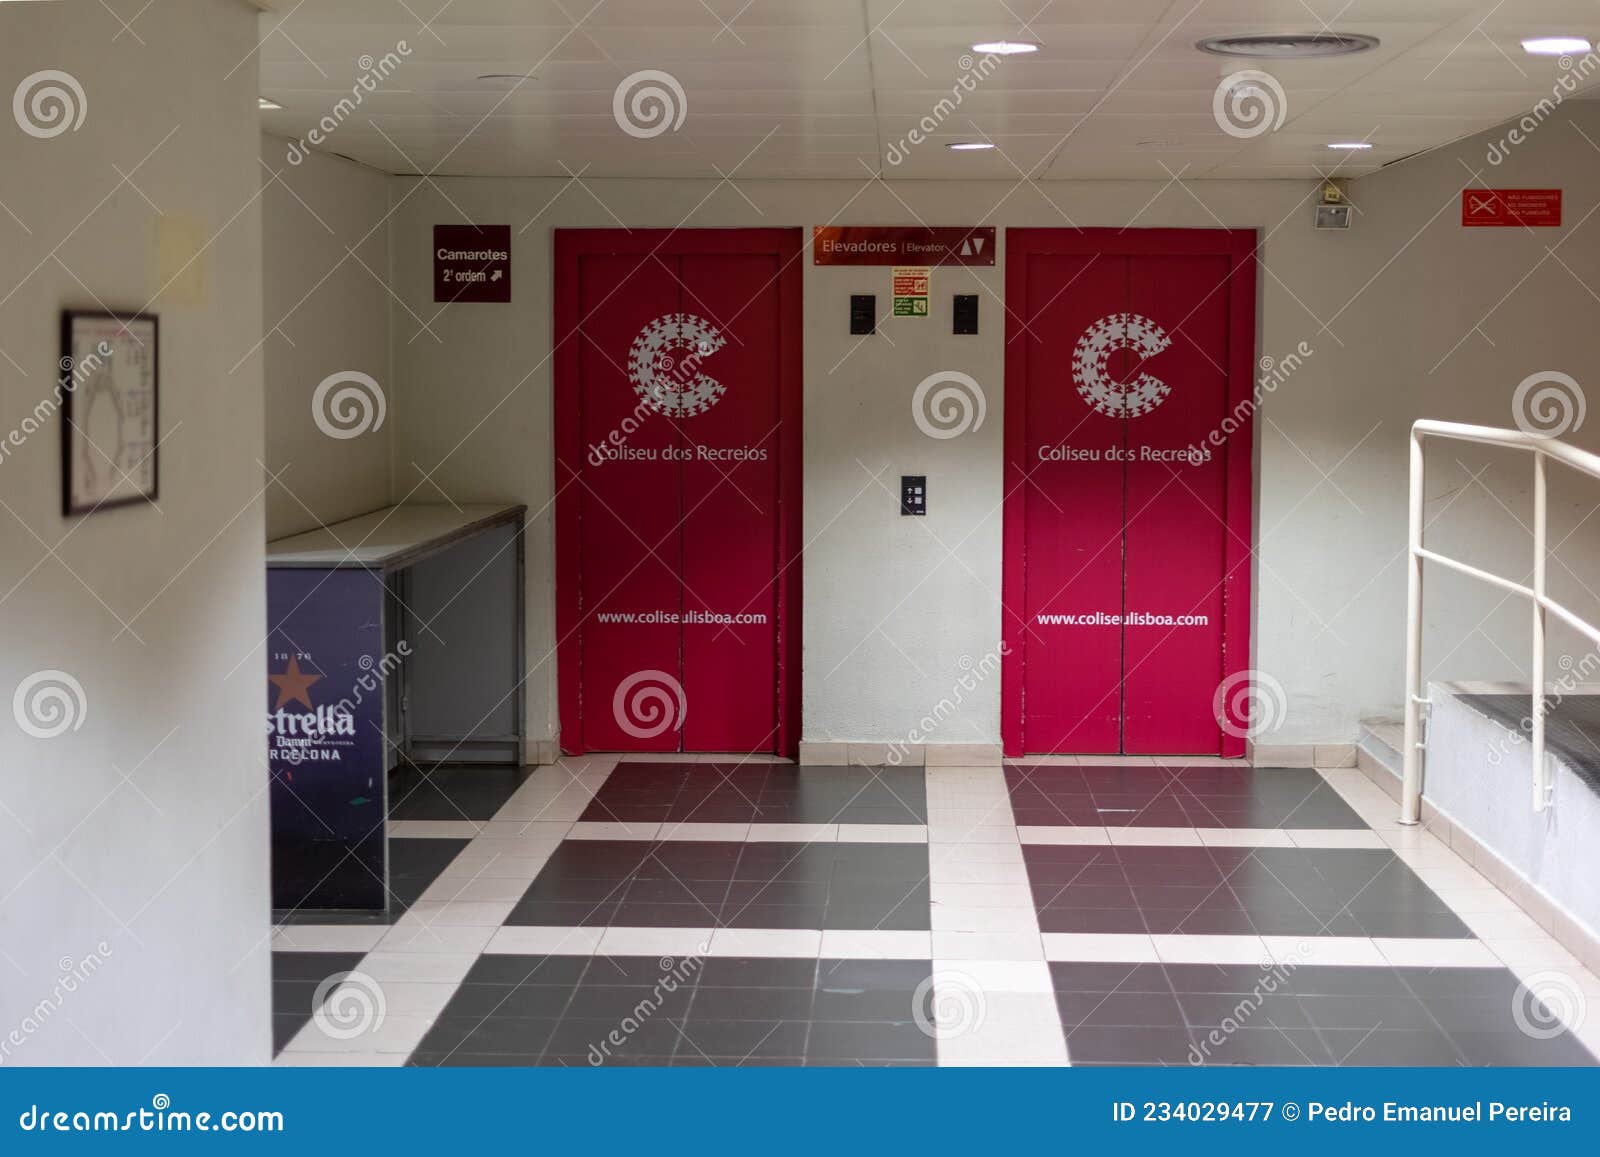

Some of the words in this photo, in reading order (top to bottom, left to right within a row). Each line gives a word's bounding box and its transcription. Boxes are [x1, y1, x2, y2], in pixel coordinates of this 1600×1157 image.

[823, 240, 897, 253] Elevadores
[437, 248, 508, 260] Camarotes
[455, 269, 486, 282] ordem
[697, 446, 767, 461] Recreios
[1038, 445, 1100, 461] Coliseu
[597, 610, 767, 624] www.coliseulisboa.com
[1037, 611, 1208, 626] www.coliseulisboa.com
[267, 704, 356, 736] strella
[270, 749, 341, 760] RCELONA
